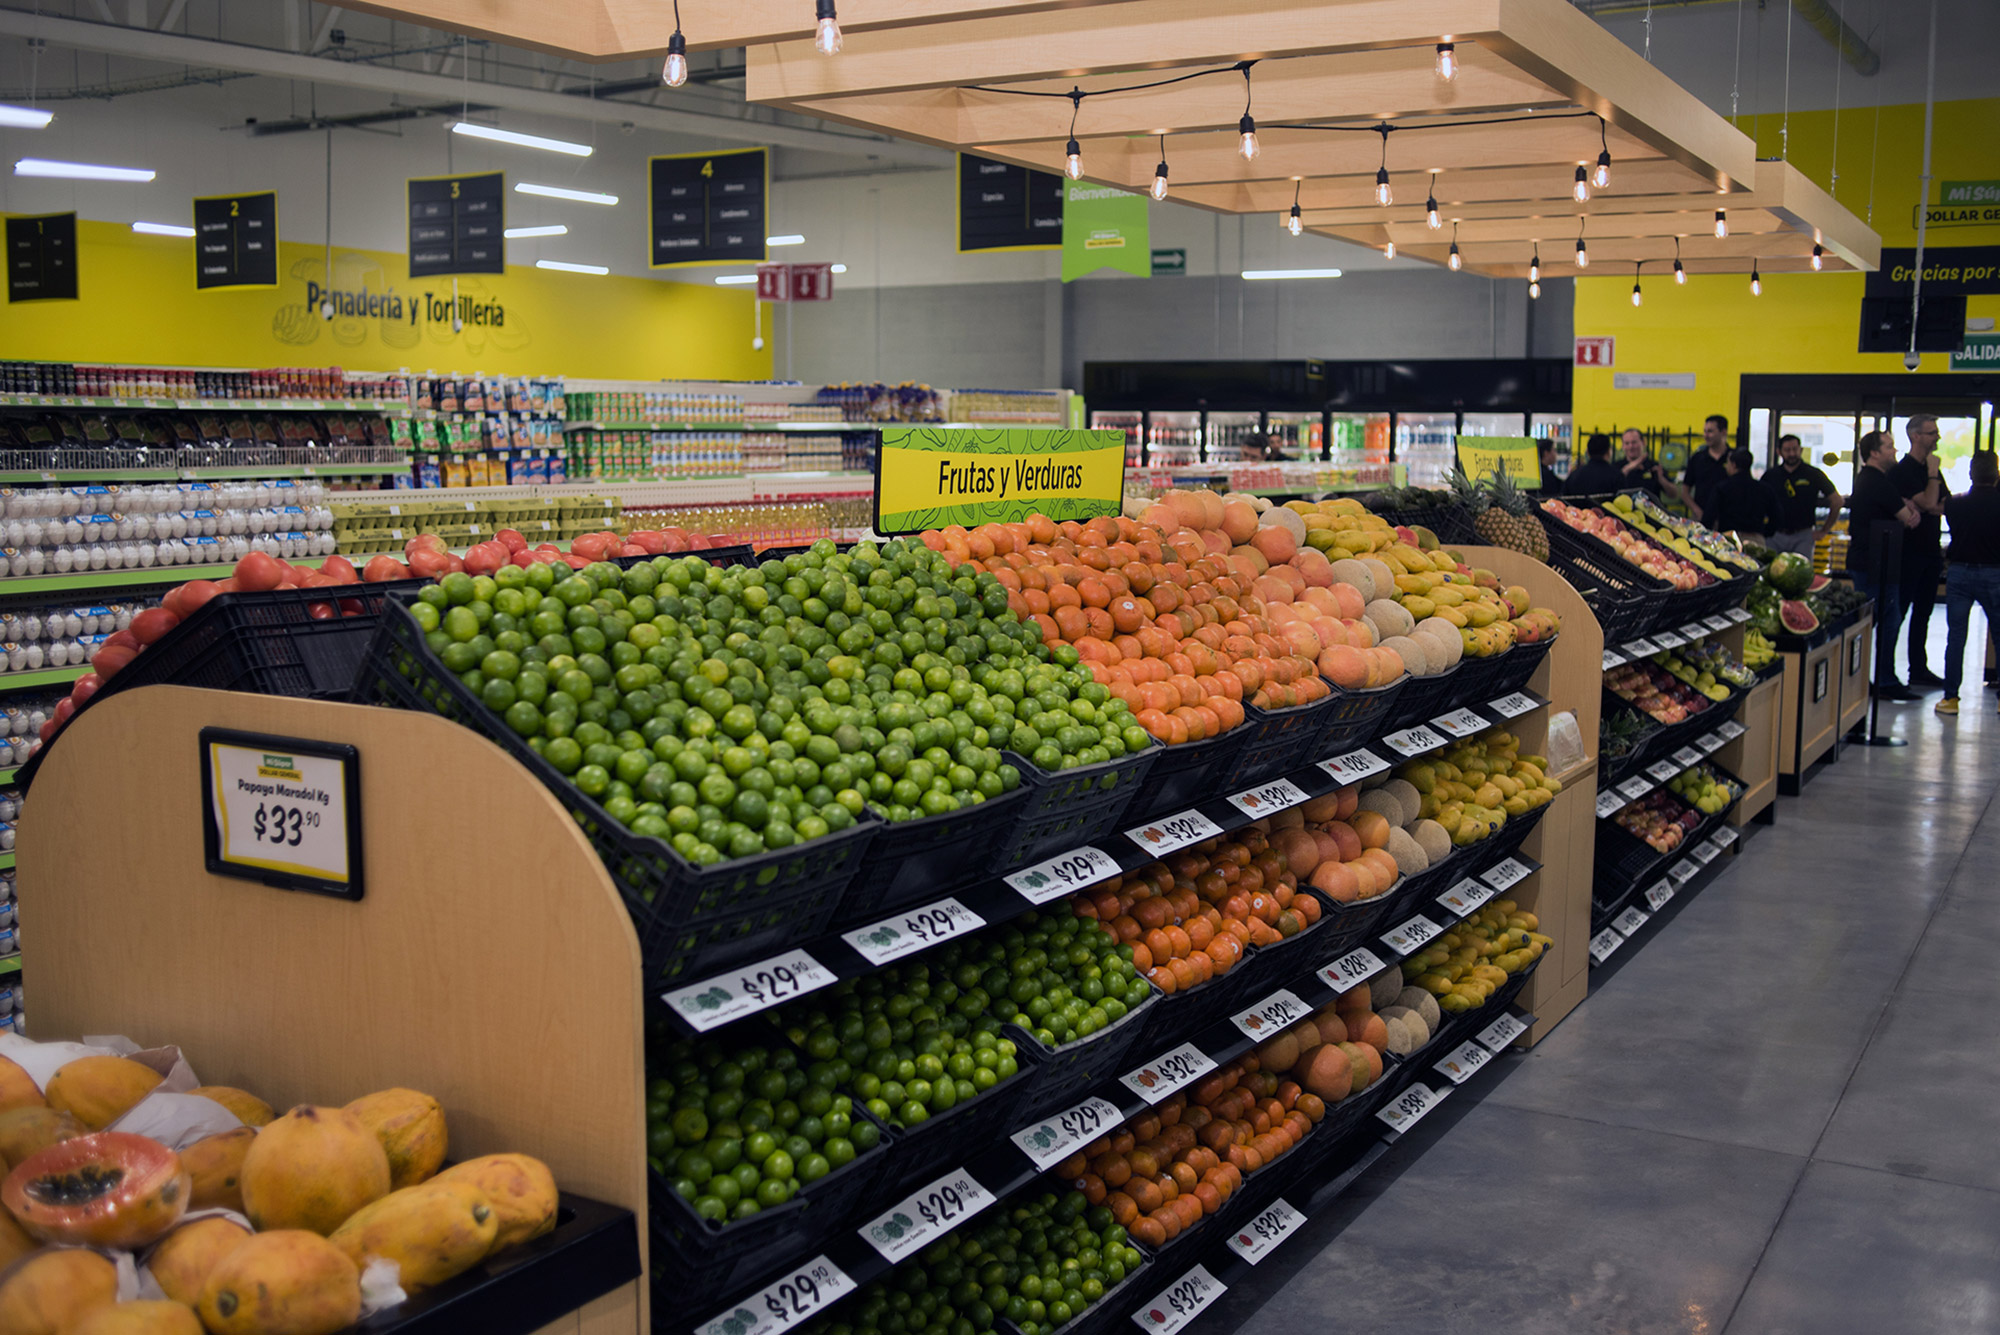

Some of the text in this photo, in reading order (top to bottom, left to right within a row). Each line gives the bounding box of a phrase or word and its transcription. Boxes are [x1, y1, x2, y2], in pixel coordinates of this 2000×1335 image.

[701, 160, 713, 178] 4
[450, 182, 460, 199] 3
[230, 200, 239, 217] 2
[1962, 266, 1996, 284] por
[307, 280, 402, 320] Panadería
[409, 295, 418, 326] y
[939, 457, 1082, 499] Frutas y Verduras
[238, 778, 329, 806] Papaya Maradol Kg
